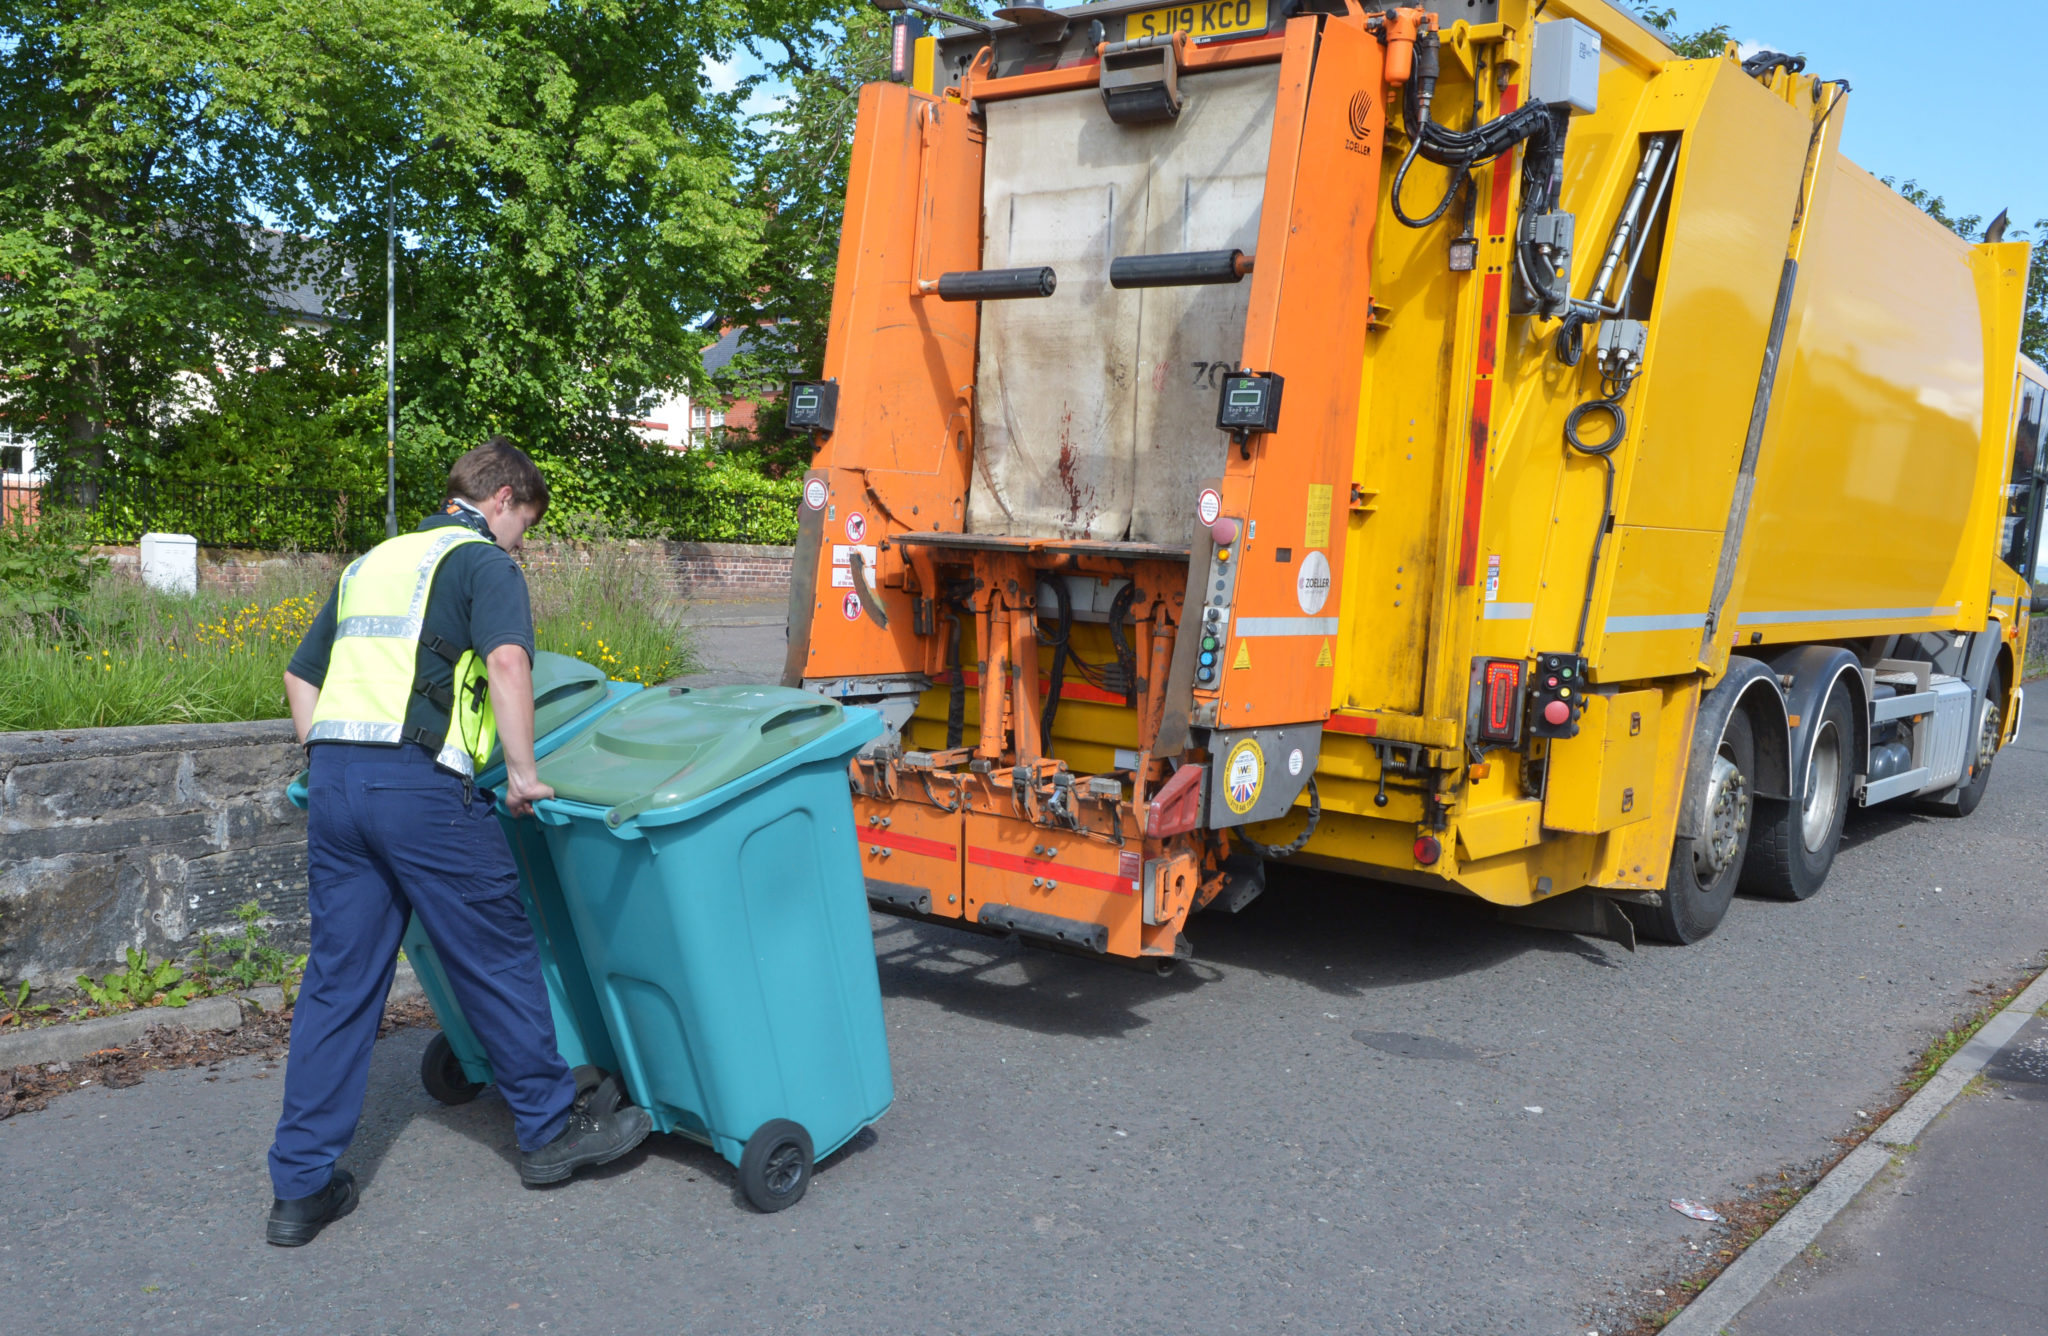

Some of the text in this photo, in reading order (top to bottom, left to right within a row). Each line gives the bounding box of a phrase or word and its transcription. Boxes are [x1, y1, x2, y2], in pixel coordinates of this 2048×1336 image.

[1141, 0, 1251, 37] SJ19 KCO
[1345, 139, 1371, 157] ZOELLER
[1305, 577, 1330, 589] ZOELLER
